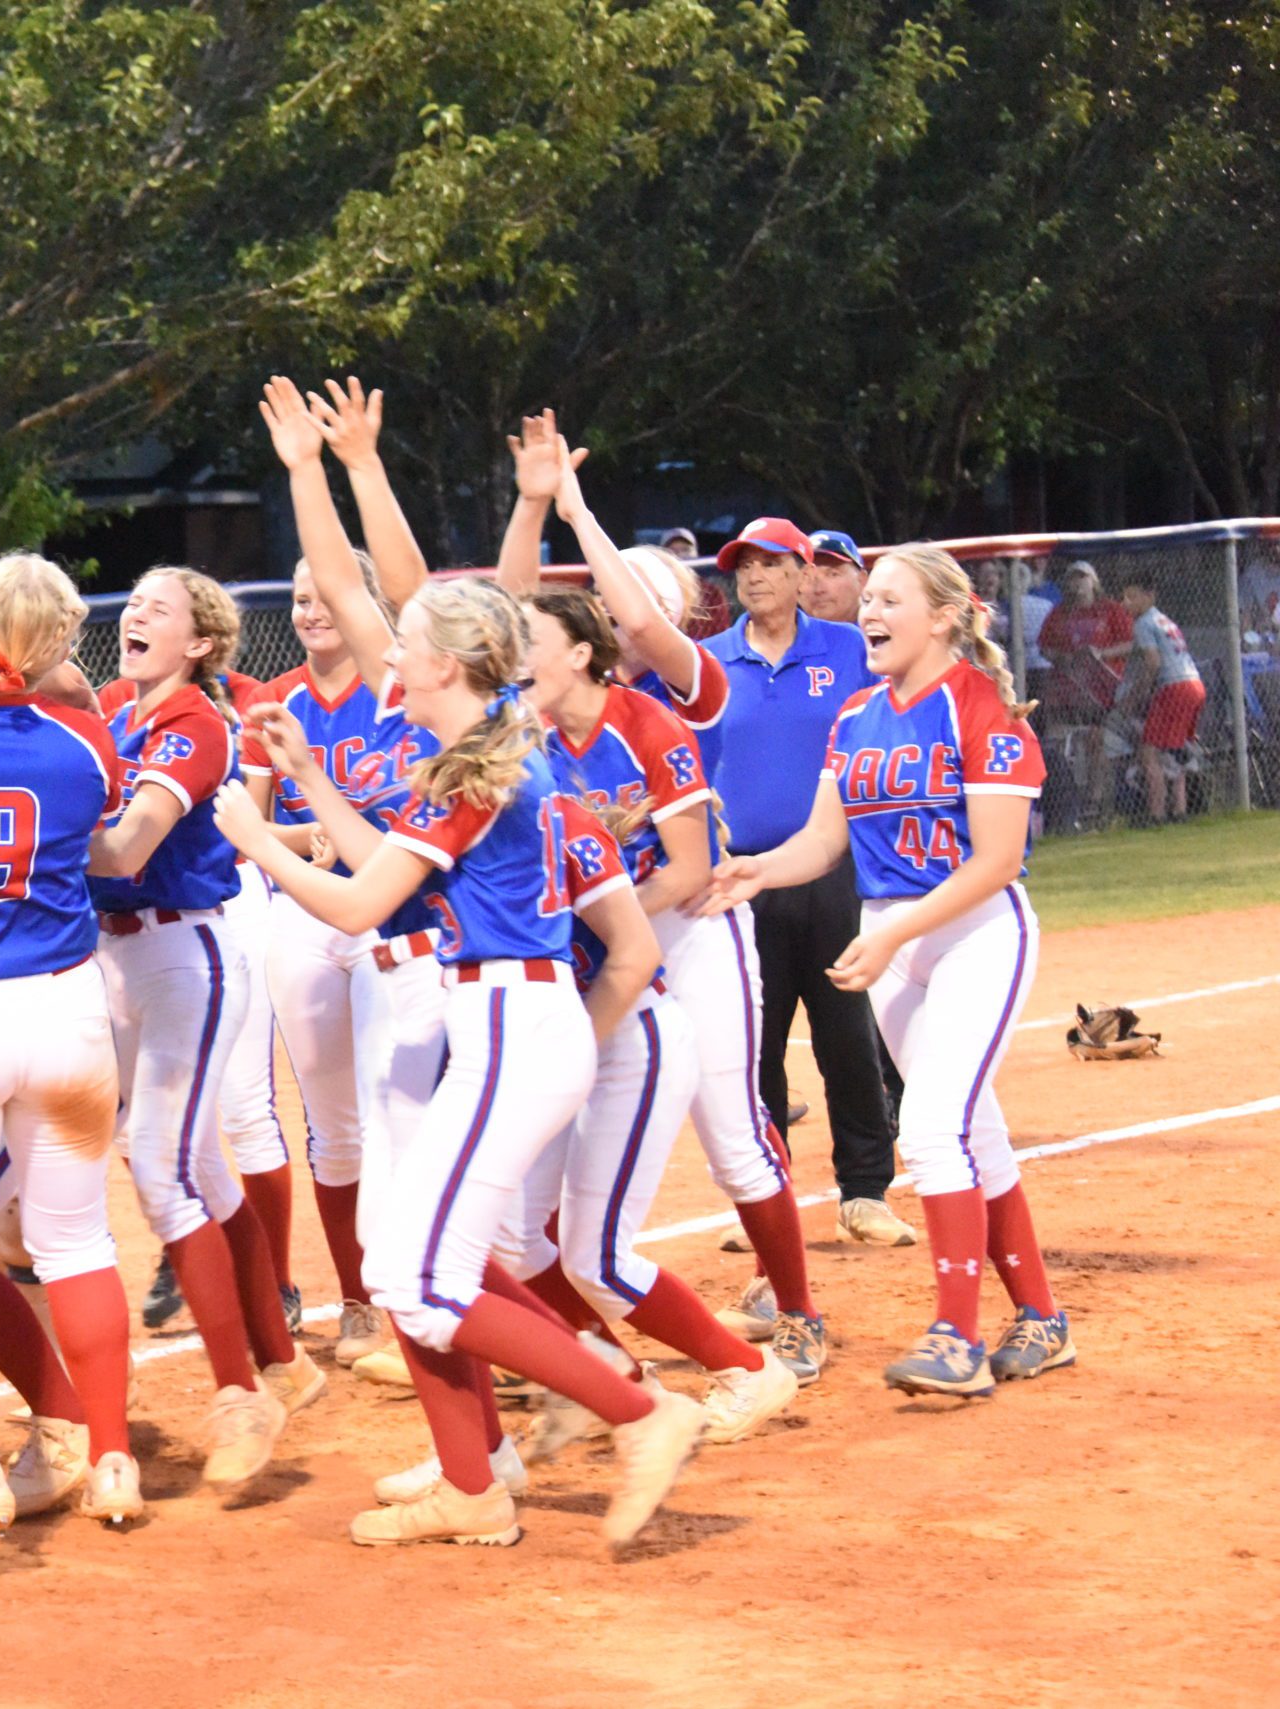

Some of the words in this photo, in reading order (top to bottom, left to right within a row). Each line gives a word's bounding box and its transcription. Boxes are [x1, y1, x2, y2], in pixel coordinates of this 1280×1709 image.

[806, 666, 835, 697] P
[149, 732, 196, 765] P
[662, 743, 697, 790] P
[831, 742, 962, 801] PACE
[984, 733, 1024, 775] P
[564, 834, 605, 882] P
[894, 815, 965, 873] 44
